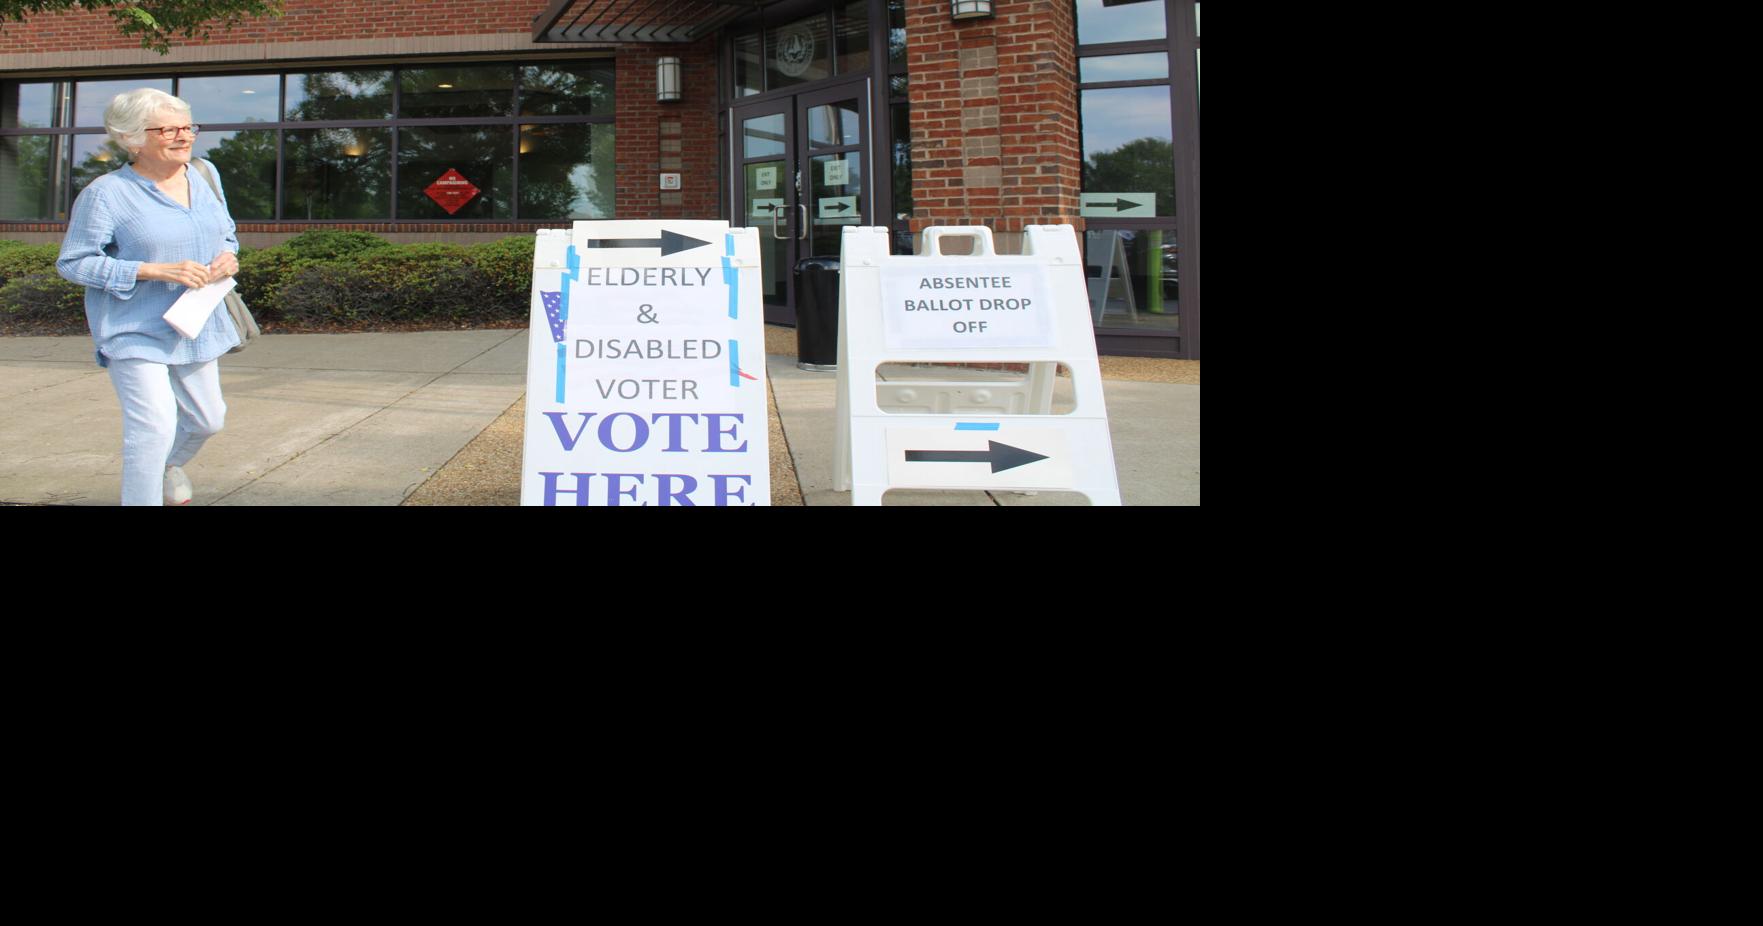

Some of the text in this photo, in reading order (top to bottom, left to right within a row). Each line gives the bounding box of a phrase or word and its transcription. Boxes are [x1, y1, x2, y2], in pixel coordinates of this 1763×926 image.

[587, 267, 712, 287] ELDERLY
[919, 276, 1012, 289] ABSENTEE
[636, 304, 660, 324] &
[904, 298, 1032, 312] BALLOT DROP
[953, 321, 988, 333] OFF
[575, 339, 722, 359] DISABLED
[596, 379, 699, 400] VOTER
[542, 412, 748, 453] VOTE
[538, 471, 755, 506] HERE
